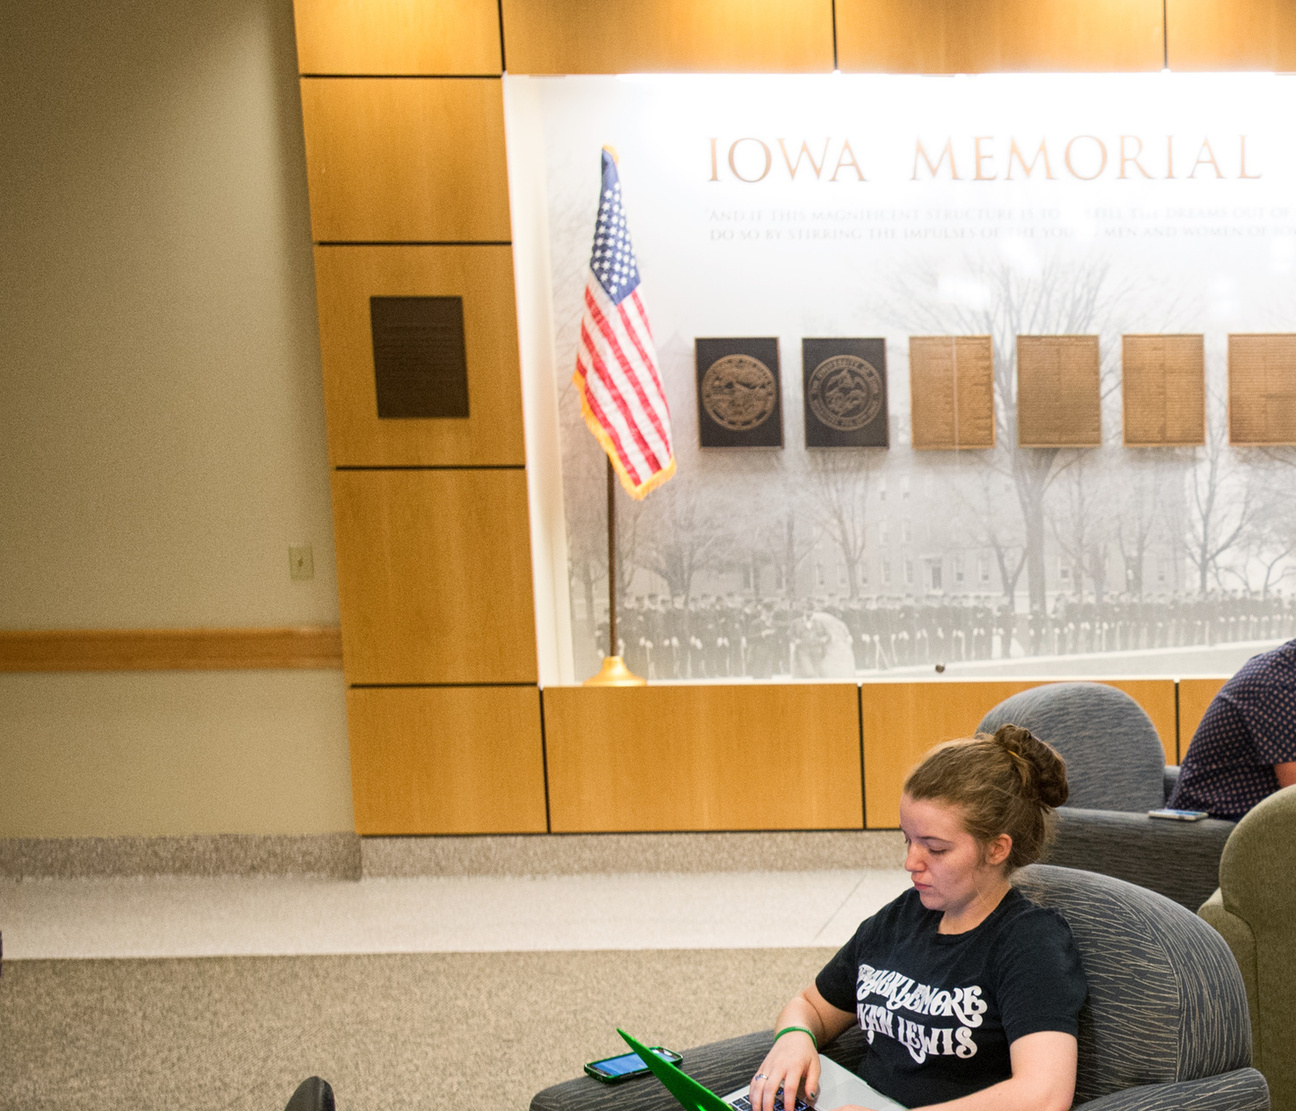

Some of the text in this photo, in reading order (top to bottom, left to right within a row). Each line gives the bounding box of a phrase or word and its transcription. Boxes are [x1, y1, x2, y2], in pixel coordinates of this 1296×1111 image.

[706, 136, 869, 183] IOWA
[909, 134, 1263, 182] MEMORIAL
[772, 208, 806, 223] THIS
[811, 207, 920, 223] MAGNIFICENT
[925, 207, 1014, 222] STRUCTURE
[1019, 207, 1035, 222] IS
[1040, 207, 1062, 222] TO
[710, 228, 735, 242] DO
[739, 228, 761, 242] SO
[766, 228, 782, 242] BY
[787, 227, 863, 242] STIRRING
[868, 227, 896, 242] THE
[902, 227, 977, 241] IMPULSES
[979, 226, 999, 241] OF
[1103, 226, 1138, 240] MEN
[1142, 226, 1178, 240] AND
[1182, 225, 1244, 240] WOMEN
[1246, 225, 1267, 240] OF
[897, 1015, 978, 1064] LEWIS
